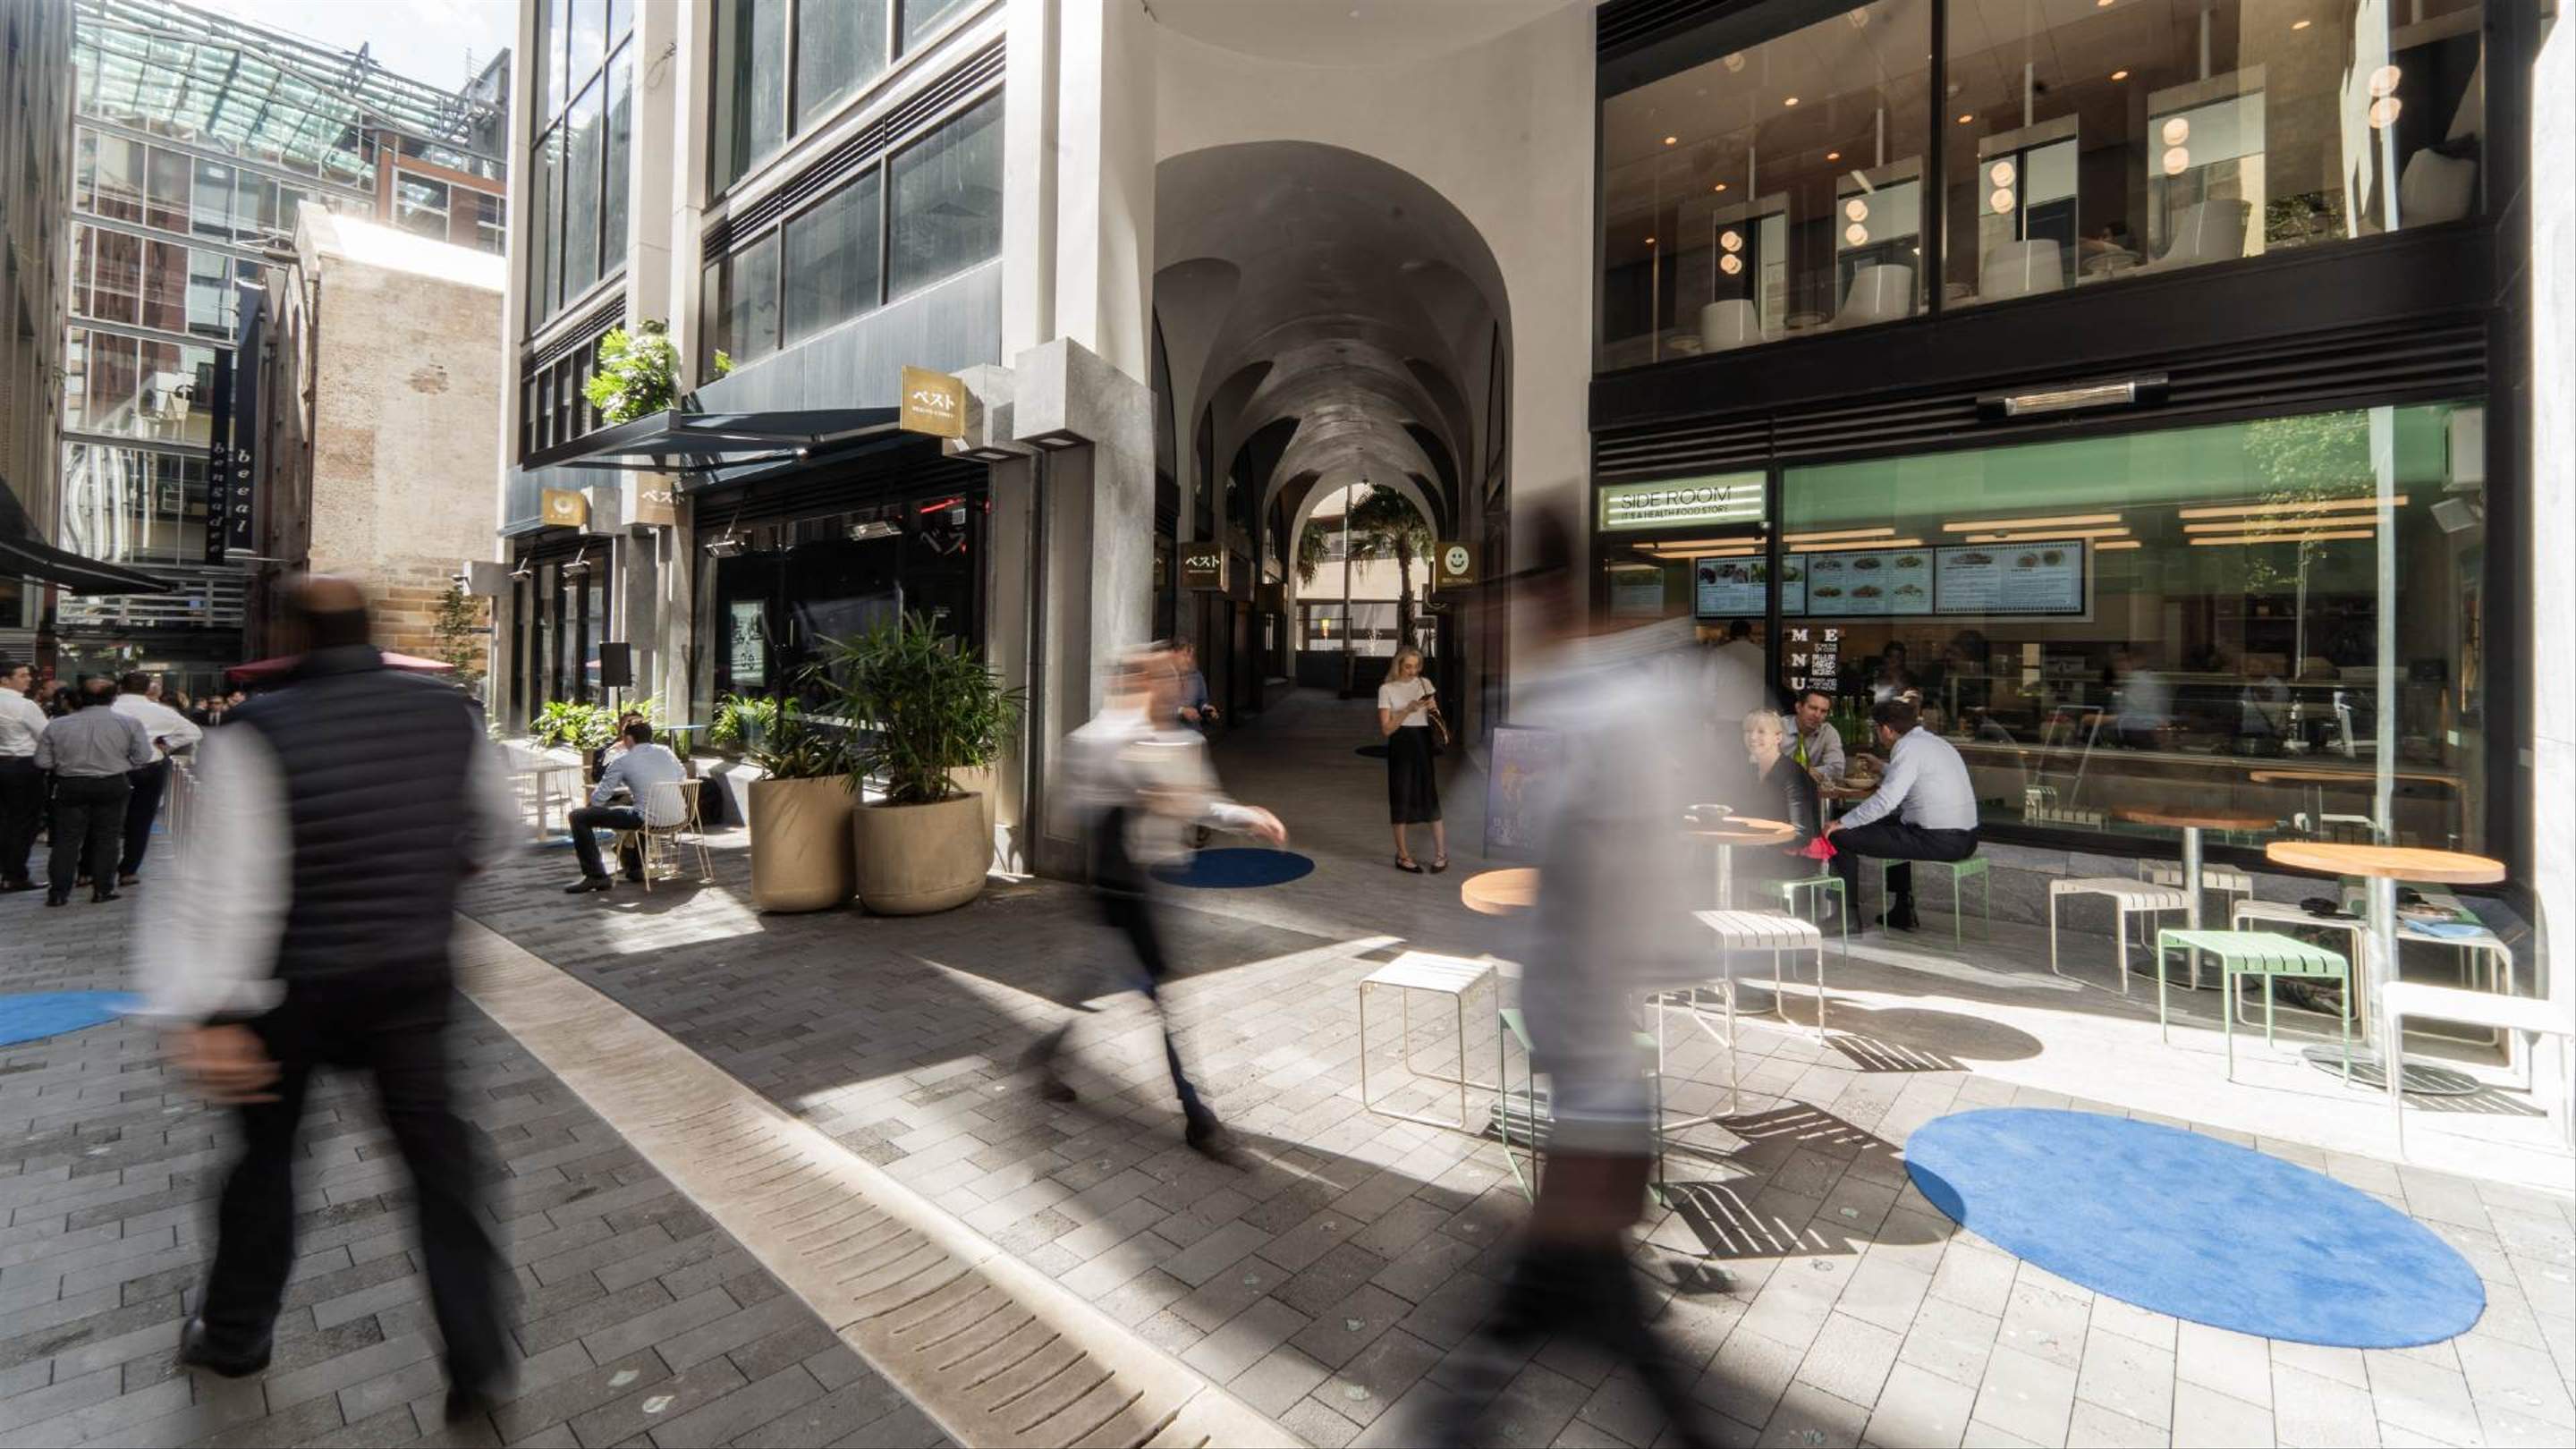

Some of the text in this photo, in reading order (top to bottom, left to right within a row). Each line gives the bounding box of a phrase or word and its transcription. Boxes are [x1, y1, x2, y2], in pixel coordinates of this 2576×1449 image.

[912, 390, 955, 411] ベスト
[235, 448, 251, 533] beeal
[1621, 486, 1732, 510] SIDE ROOM
[1644, 509, 1674, 519] HEALTH
[1675, 506, 1700, 515] FOOD
[1702, 504, 1729, 514] STORE
[1185, 555, 1220, 568] ベスト
